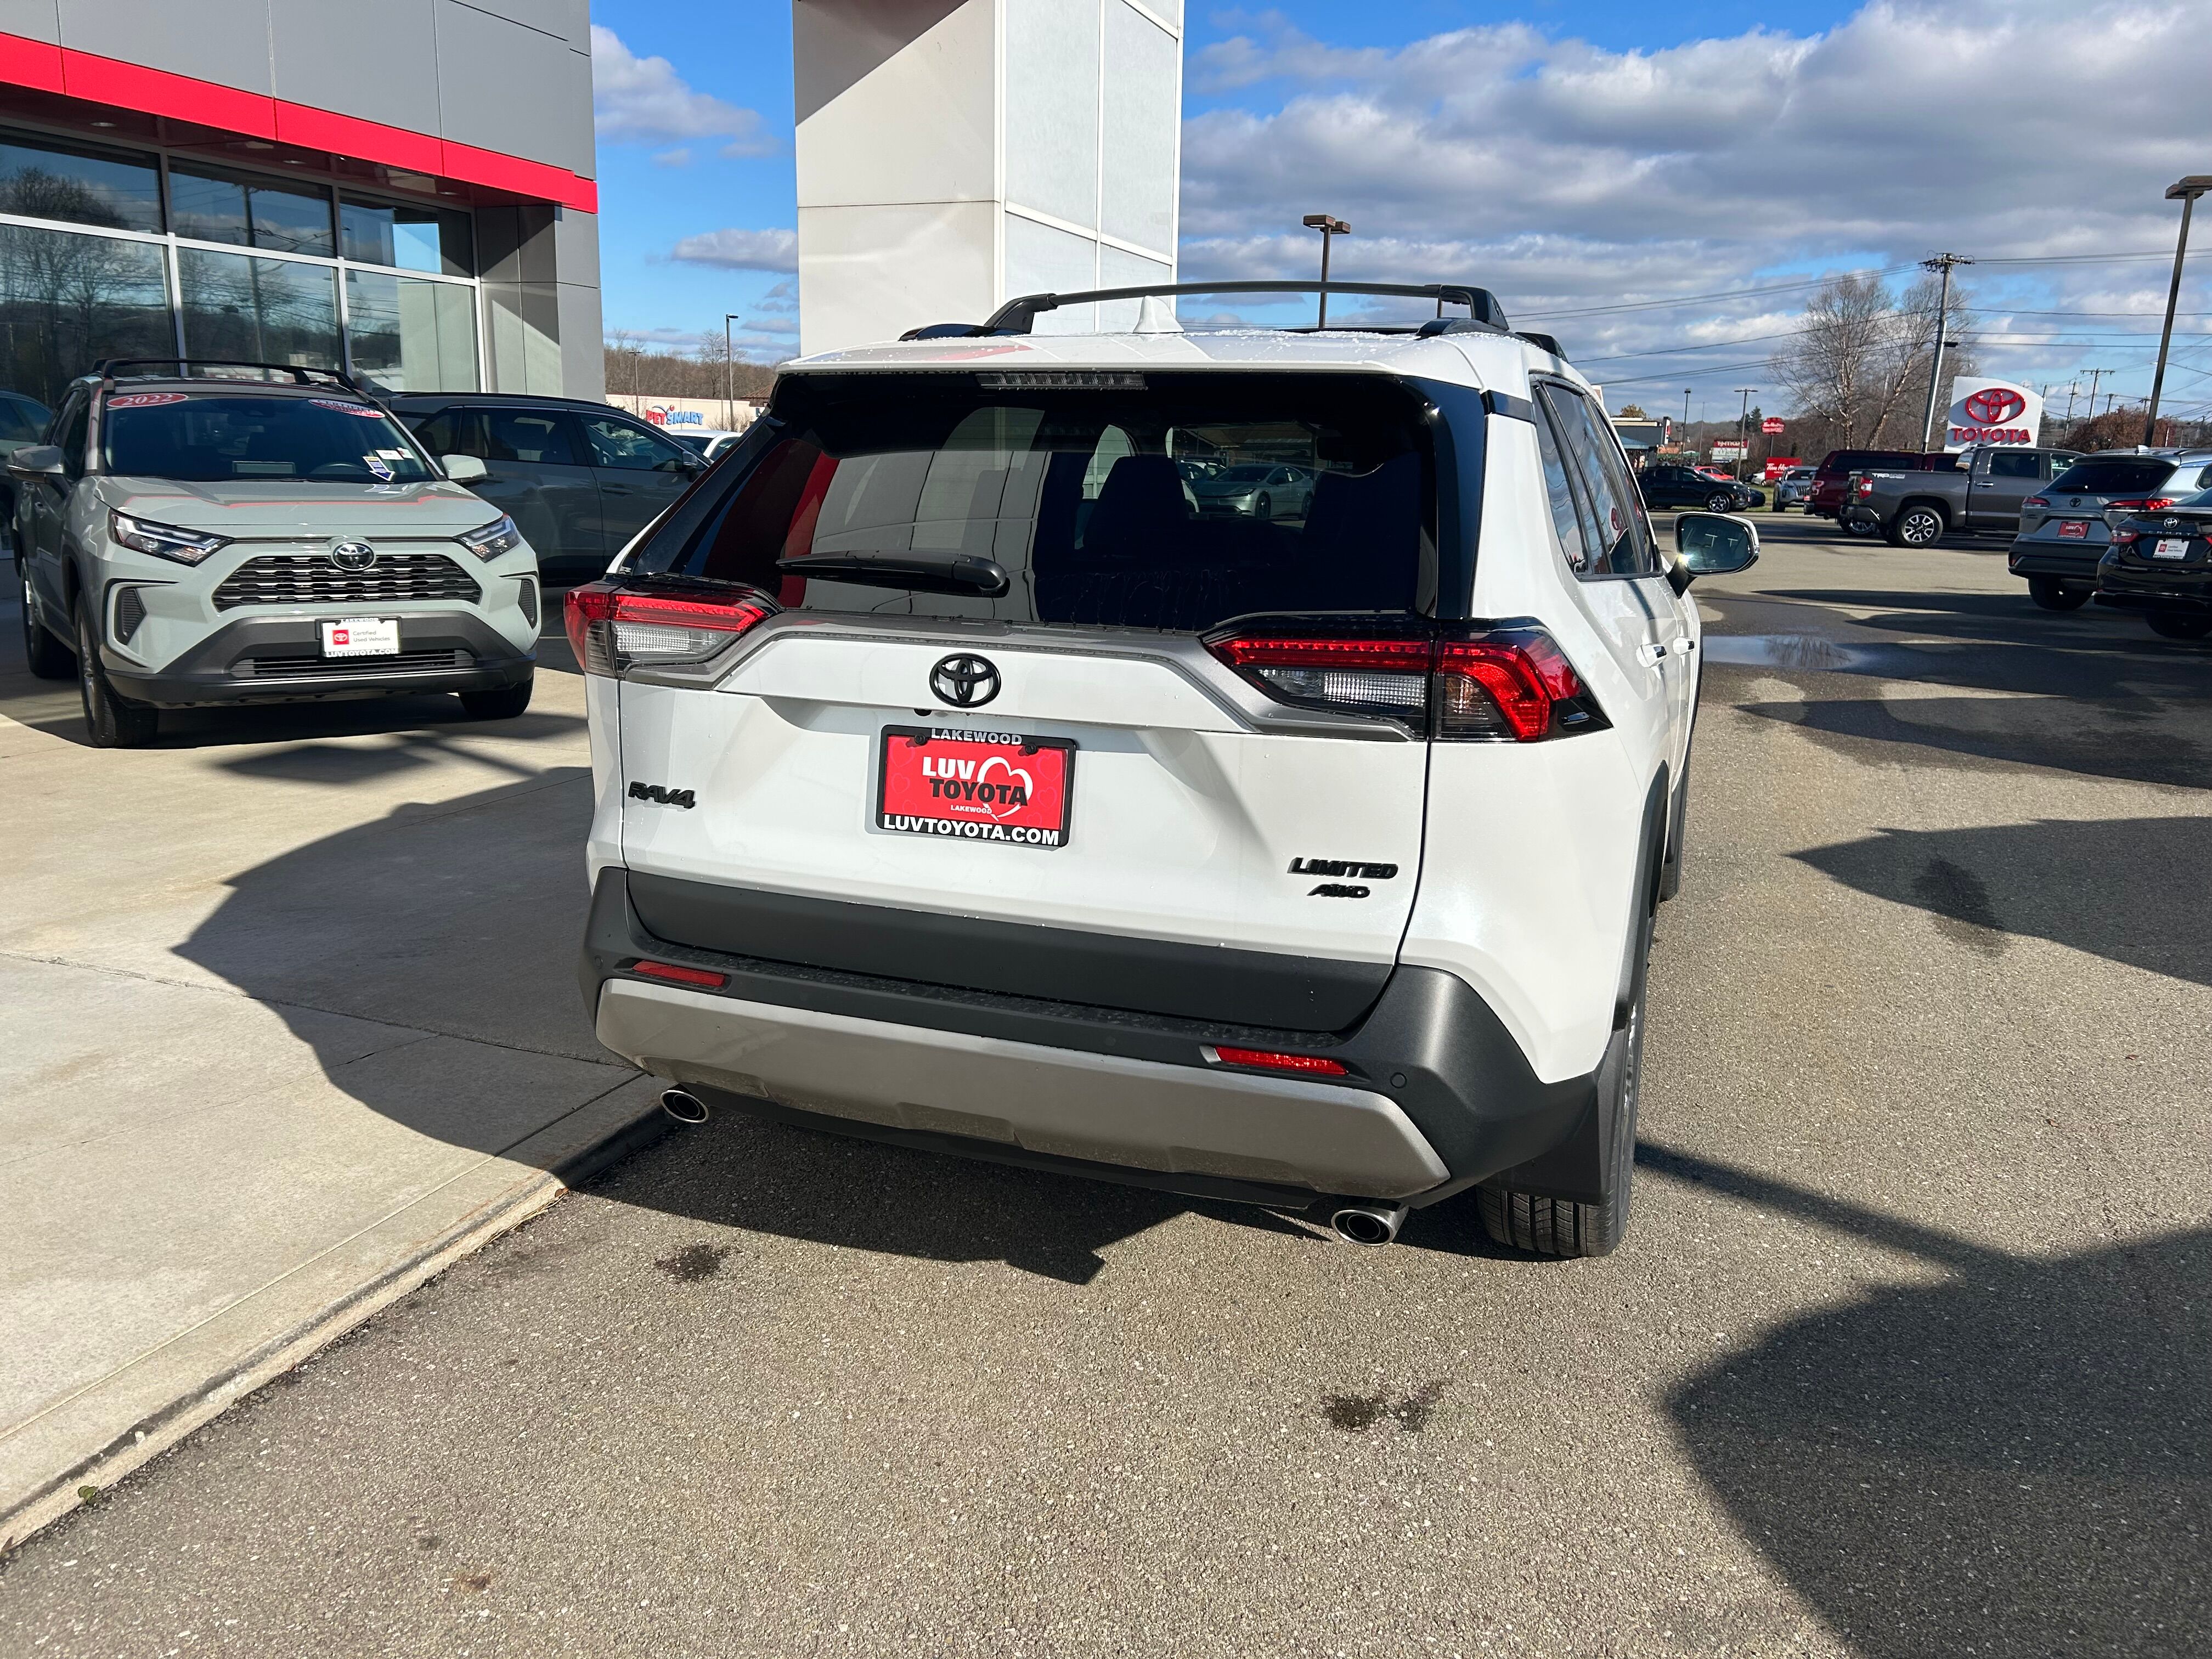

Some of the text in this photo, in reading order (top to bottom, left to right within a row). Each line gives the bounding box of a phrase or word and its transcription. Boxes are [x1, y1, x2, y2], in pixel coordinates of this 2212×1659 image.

[122, 394, 173, 406] 2022
[1951, 427, 2031, 442] TOYOTA
[326, 648, 398, 658] LUVTOYOTA.COM
[931, 728, 1023, 746] LAKEWOOD
[922, 756, 976, 780] LUV
[628, 781, 695, 809] RAV4
[929, 778, 1028, 806] TOYOTA
[950, 804, 992, 815] LAKEWOOD
[883, 814, 1059, 845] LUVTOYOTA.COM
[1287, 857, 1399, 879] LIMITED
[1306, 883, 1370, 899] AWD
